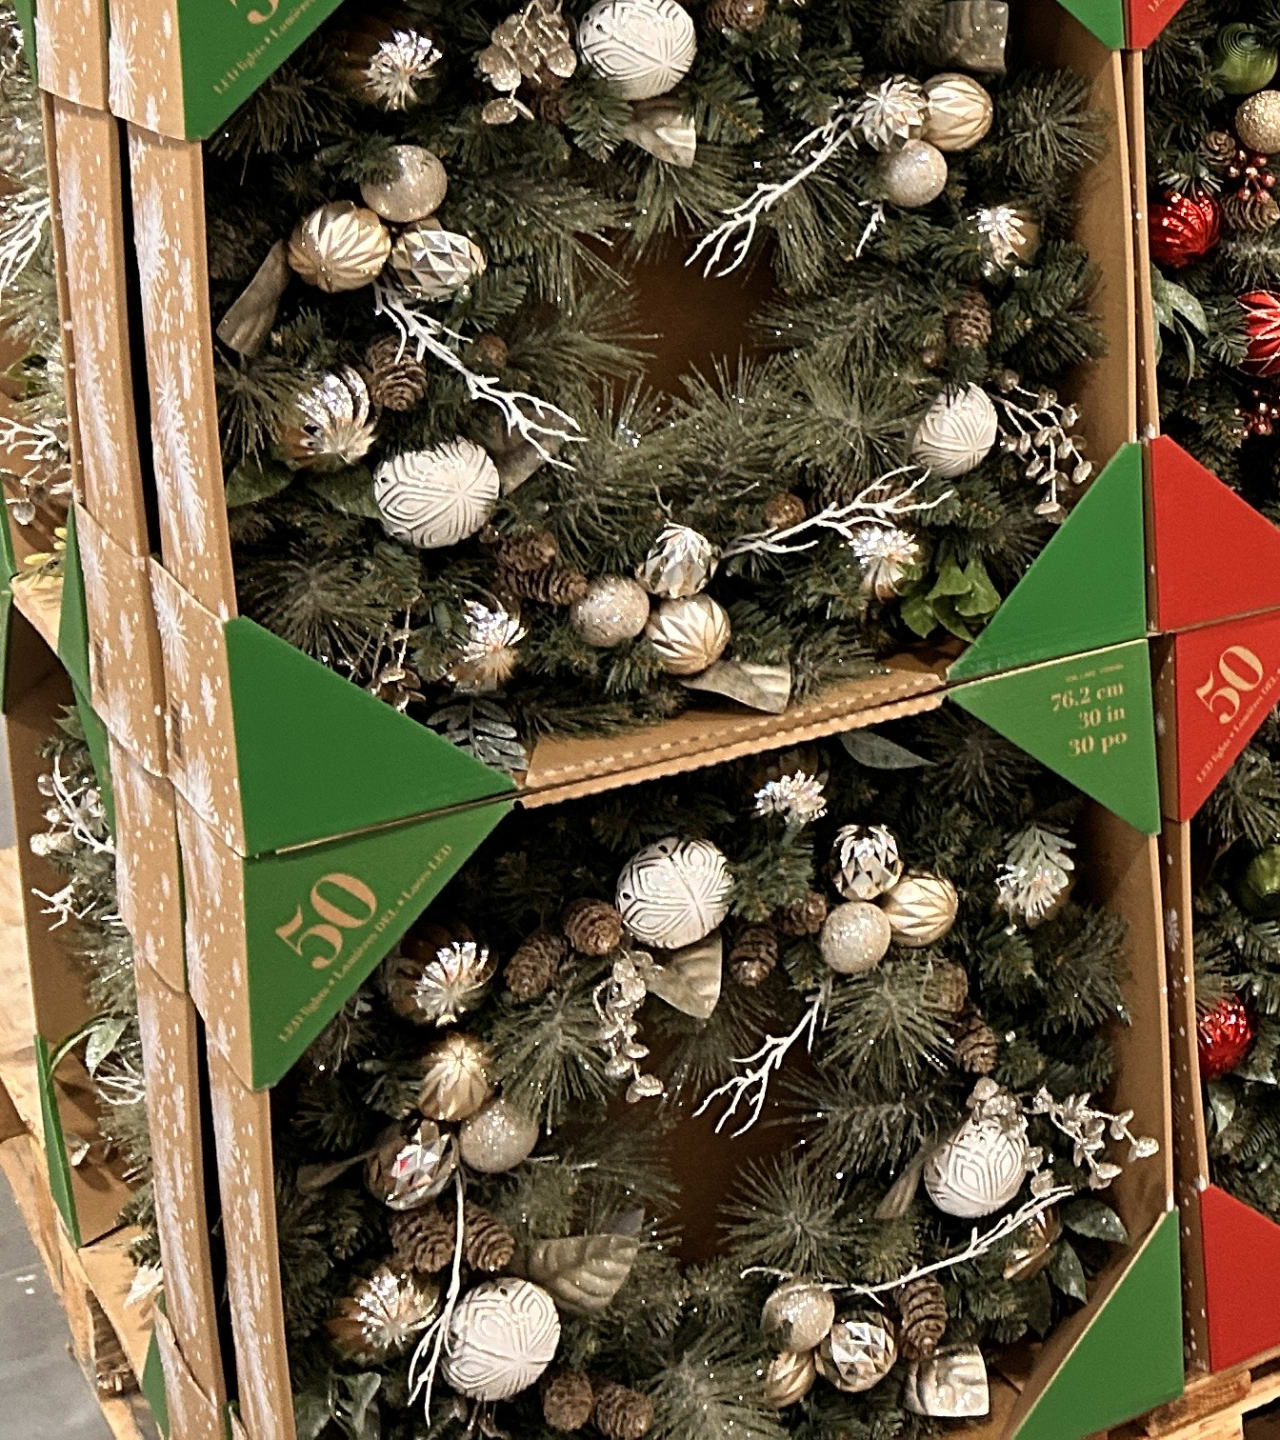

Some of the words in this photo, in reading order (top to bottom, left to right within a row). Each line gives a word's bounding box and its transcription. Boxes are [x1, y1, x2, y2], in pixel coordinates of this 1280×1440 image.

[1050, 688, 1091, 713] 76.2
[1096, 682, 1124, 701] cm
[1195, 644, 1265, 725] 50
[1077, 706, 1102, 730] 30
[1107, 706, 1126, 723] in
[1067, 734, 1095, 759] 30
[1101, 731, 1127, 755] po
[275, 872, 378, 970] 50
